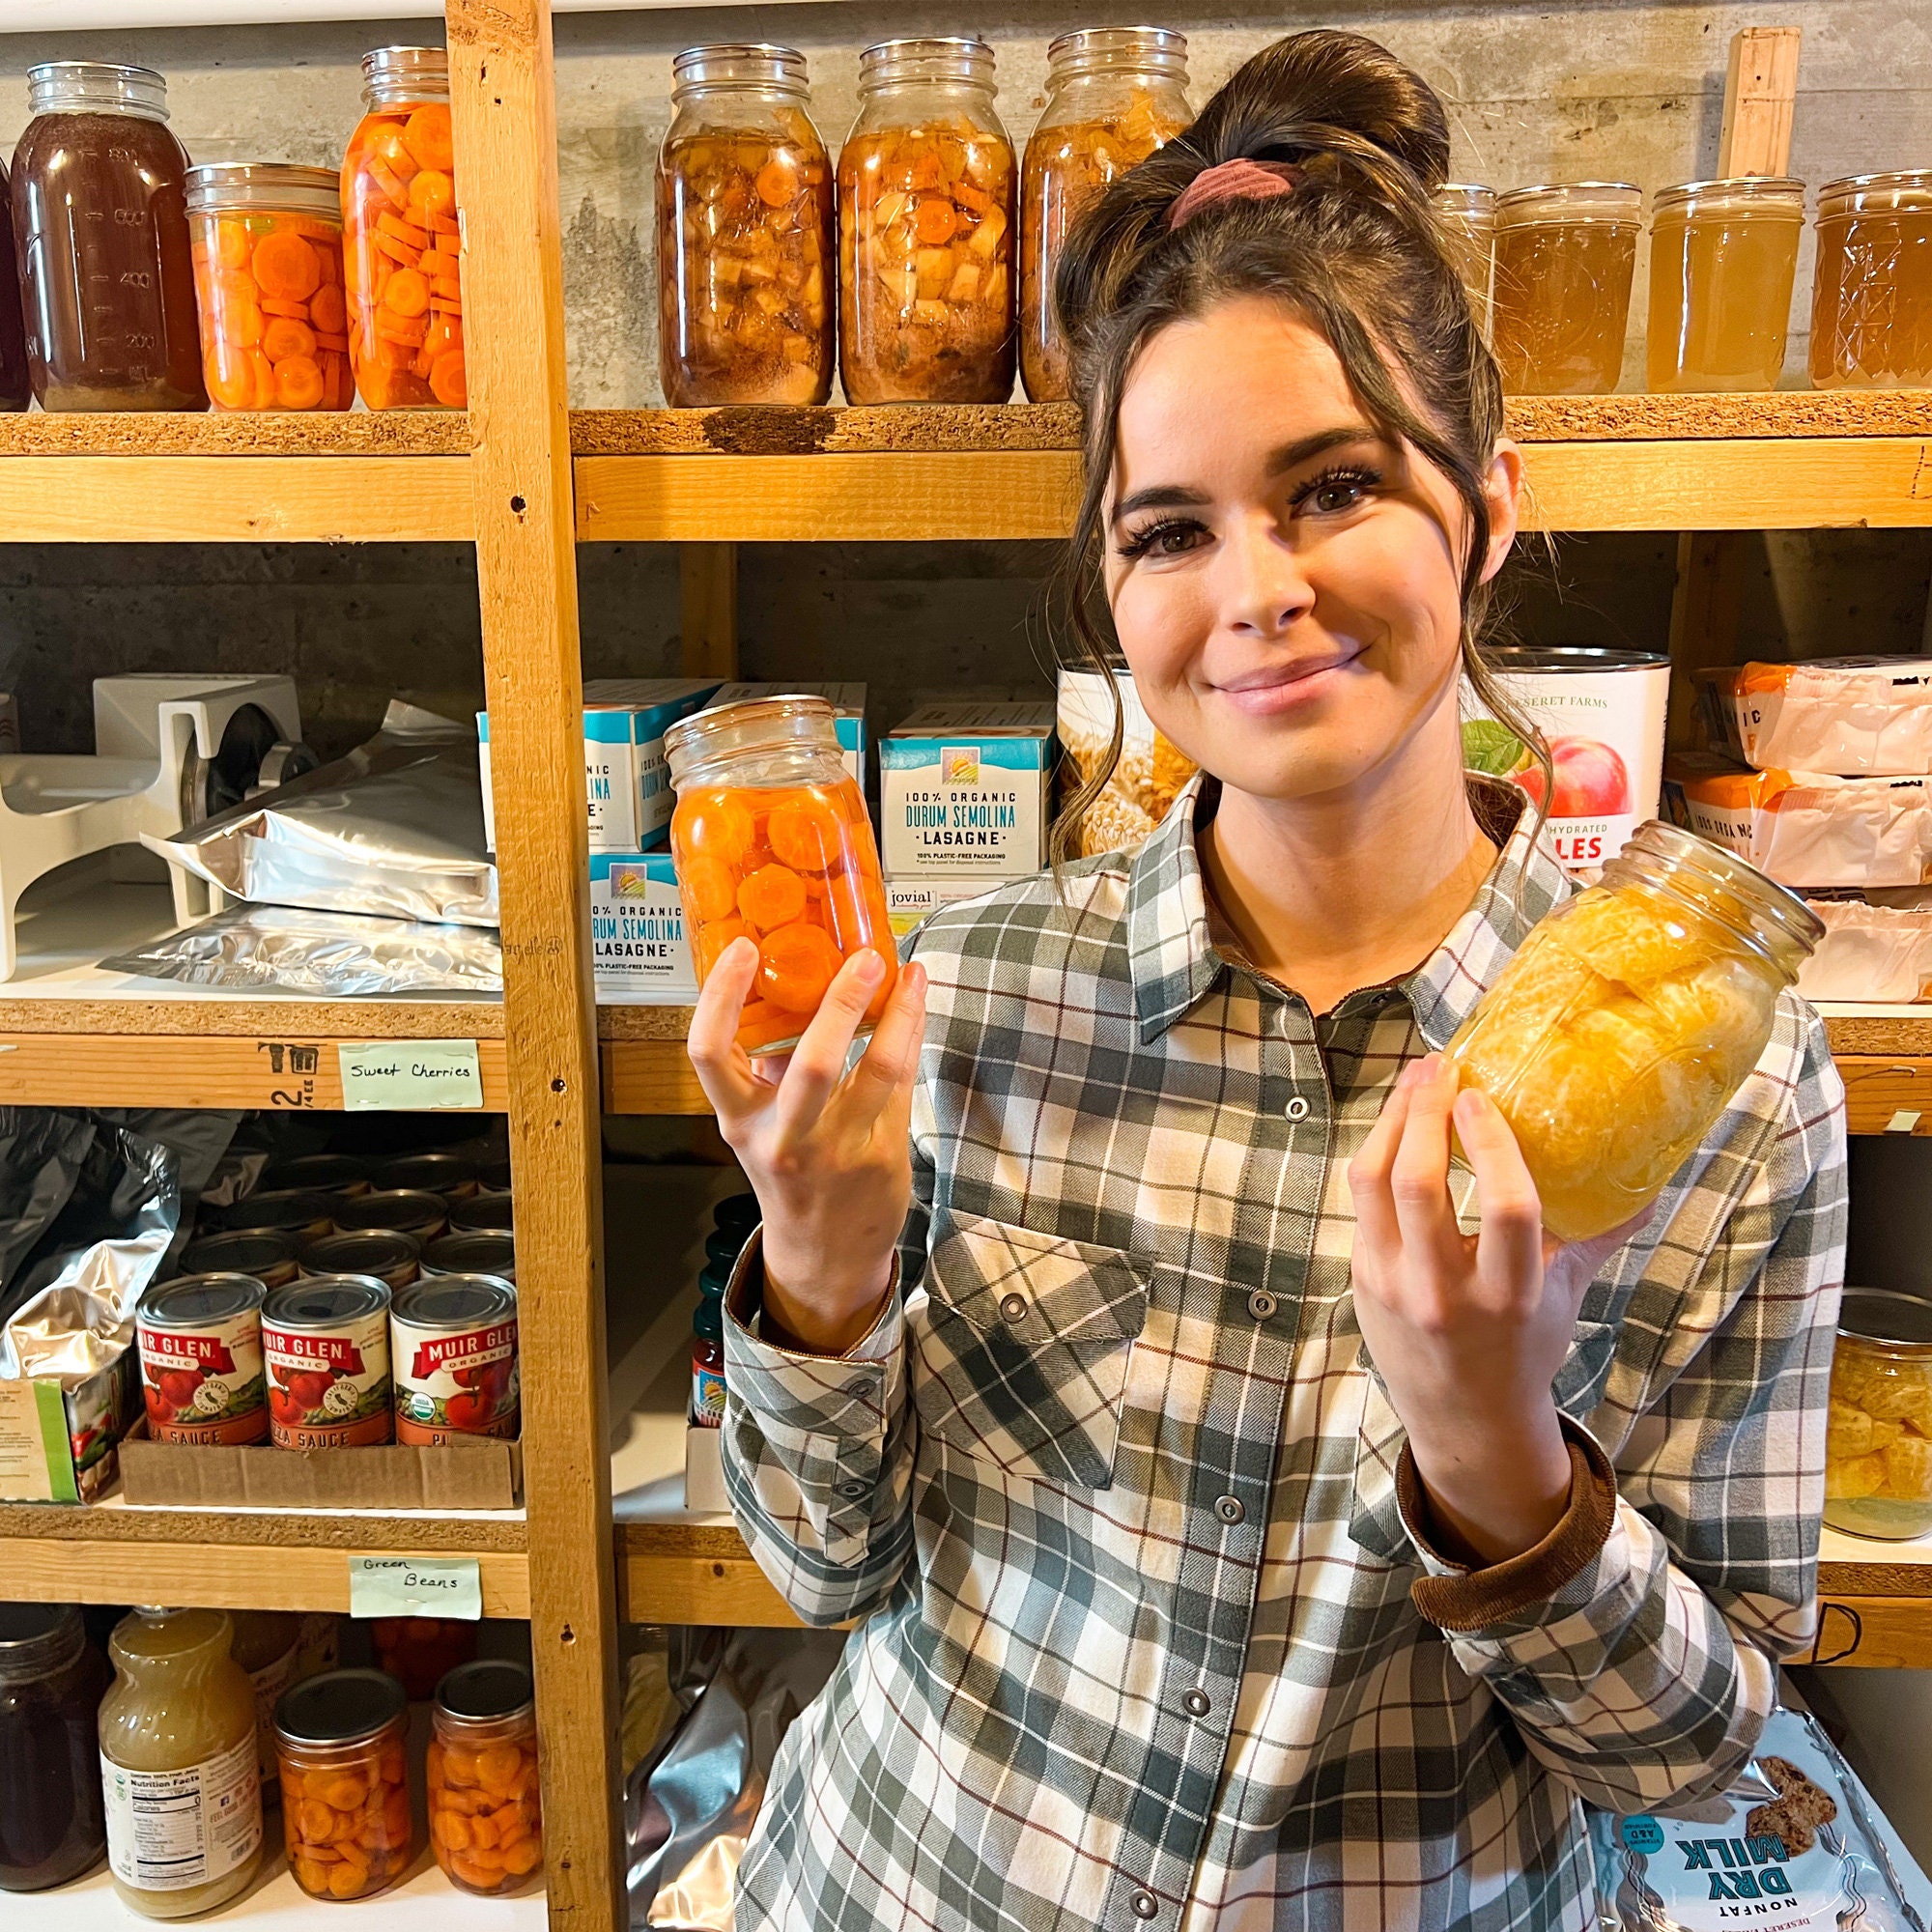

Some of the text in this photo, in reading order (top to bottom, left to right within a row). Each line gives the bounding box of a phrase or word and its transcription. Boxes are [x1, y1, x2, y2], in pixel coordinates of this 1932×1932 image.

[1518, 696, 1607, 709] SERET FARMS
[906, 792, 1016, 803] 100% ORGANIC
[906, 805, 1015, 828] DURUM SEMOLINA
[1548, 823, 1607, 835] HYDRATED
[1555, 837, 1603, 861] LES
[890, 890, 932, 907] jovial
[619, 906, 682, 917] ORGANIC
[623, 918, 683, 941] SEMOLINA
[351, 1063, 470, 1078] Sweet Cherries
[162, 1337, 212, 1358] GLEN
[293, 1338, 343, 1359] GLEN
[428, 1337, 478, 1362] MUIR
[448, 1348, 510, 1369] ORGANIC
[170, 1430, 222, 1445] SAUCE
[298, 1431, 350, 1448] SAUCE
[362, 1559, 412, 1570] Green
[404, 1573, 458, 1589] Beans
[1811, 1602, 1862, 1665] D
[130, 1776, 200, 1788] Nutrition Facts
[1675, 1833, 1790, 1871] MILK
[1708, 1866, 1794, 1901] DRY
[1719, 1897, 1799, 1918] NONFAT
